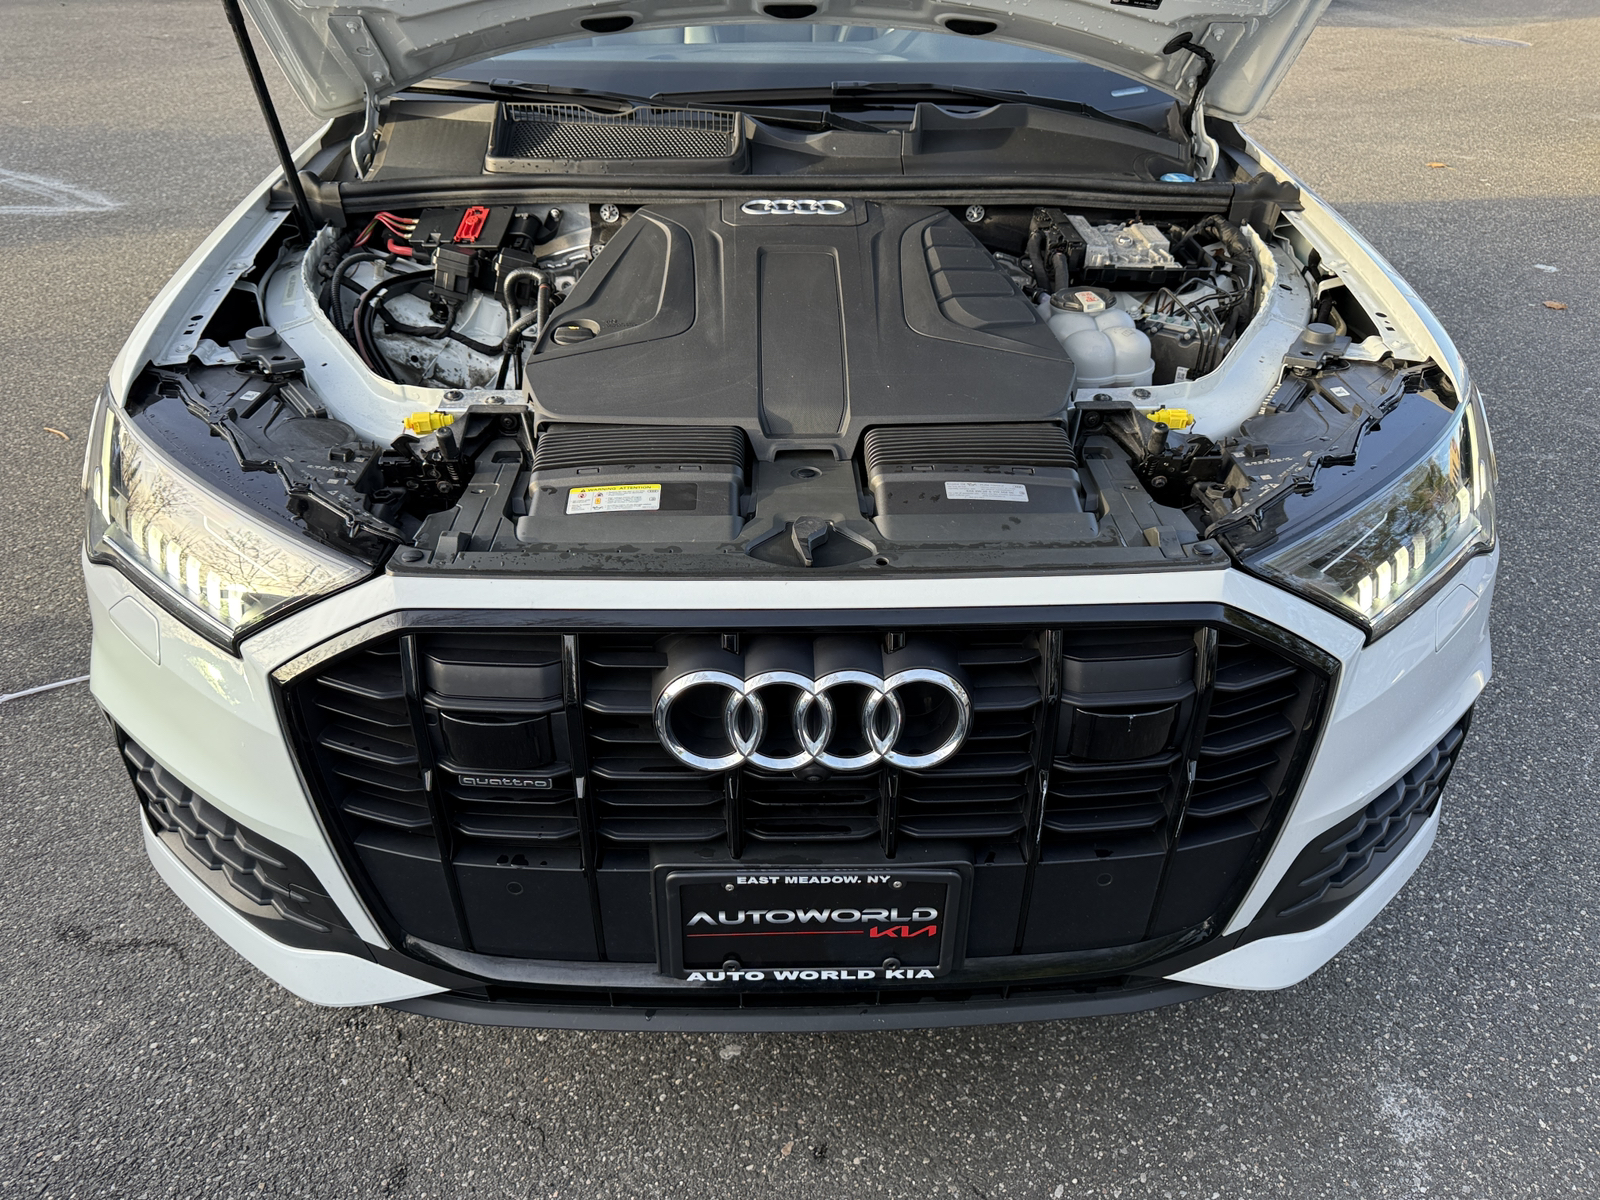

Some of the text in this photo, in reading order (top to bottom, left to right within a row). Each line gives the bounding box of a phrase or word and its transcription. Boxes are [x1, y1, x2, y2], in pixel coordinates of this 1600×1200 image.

[462, 777, 547, 787] quattro
[736, 876, 780, 885] EAST
[866, 874, 891, 884] NY
[687, 907, 938, 925] AUTOWORLD
[869, 925, 937, 938] KIA
[686, 968, 935, 982] AUTO WORLD KIA
